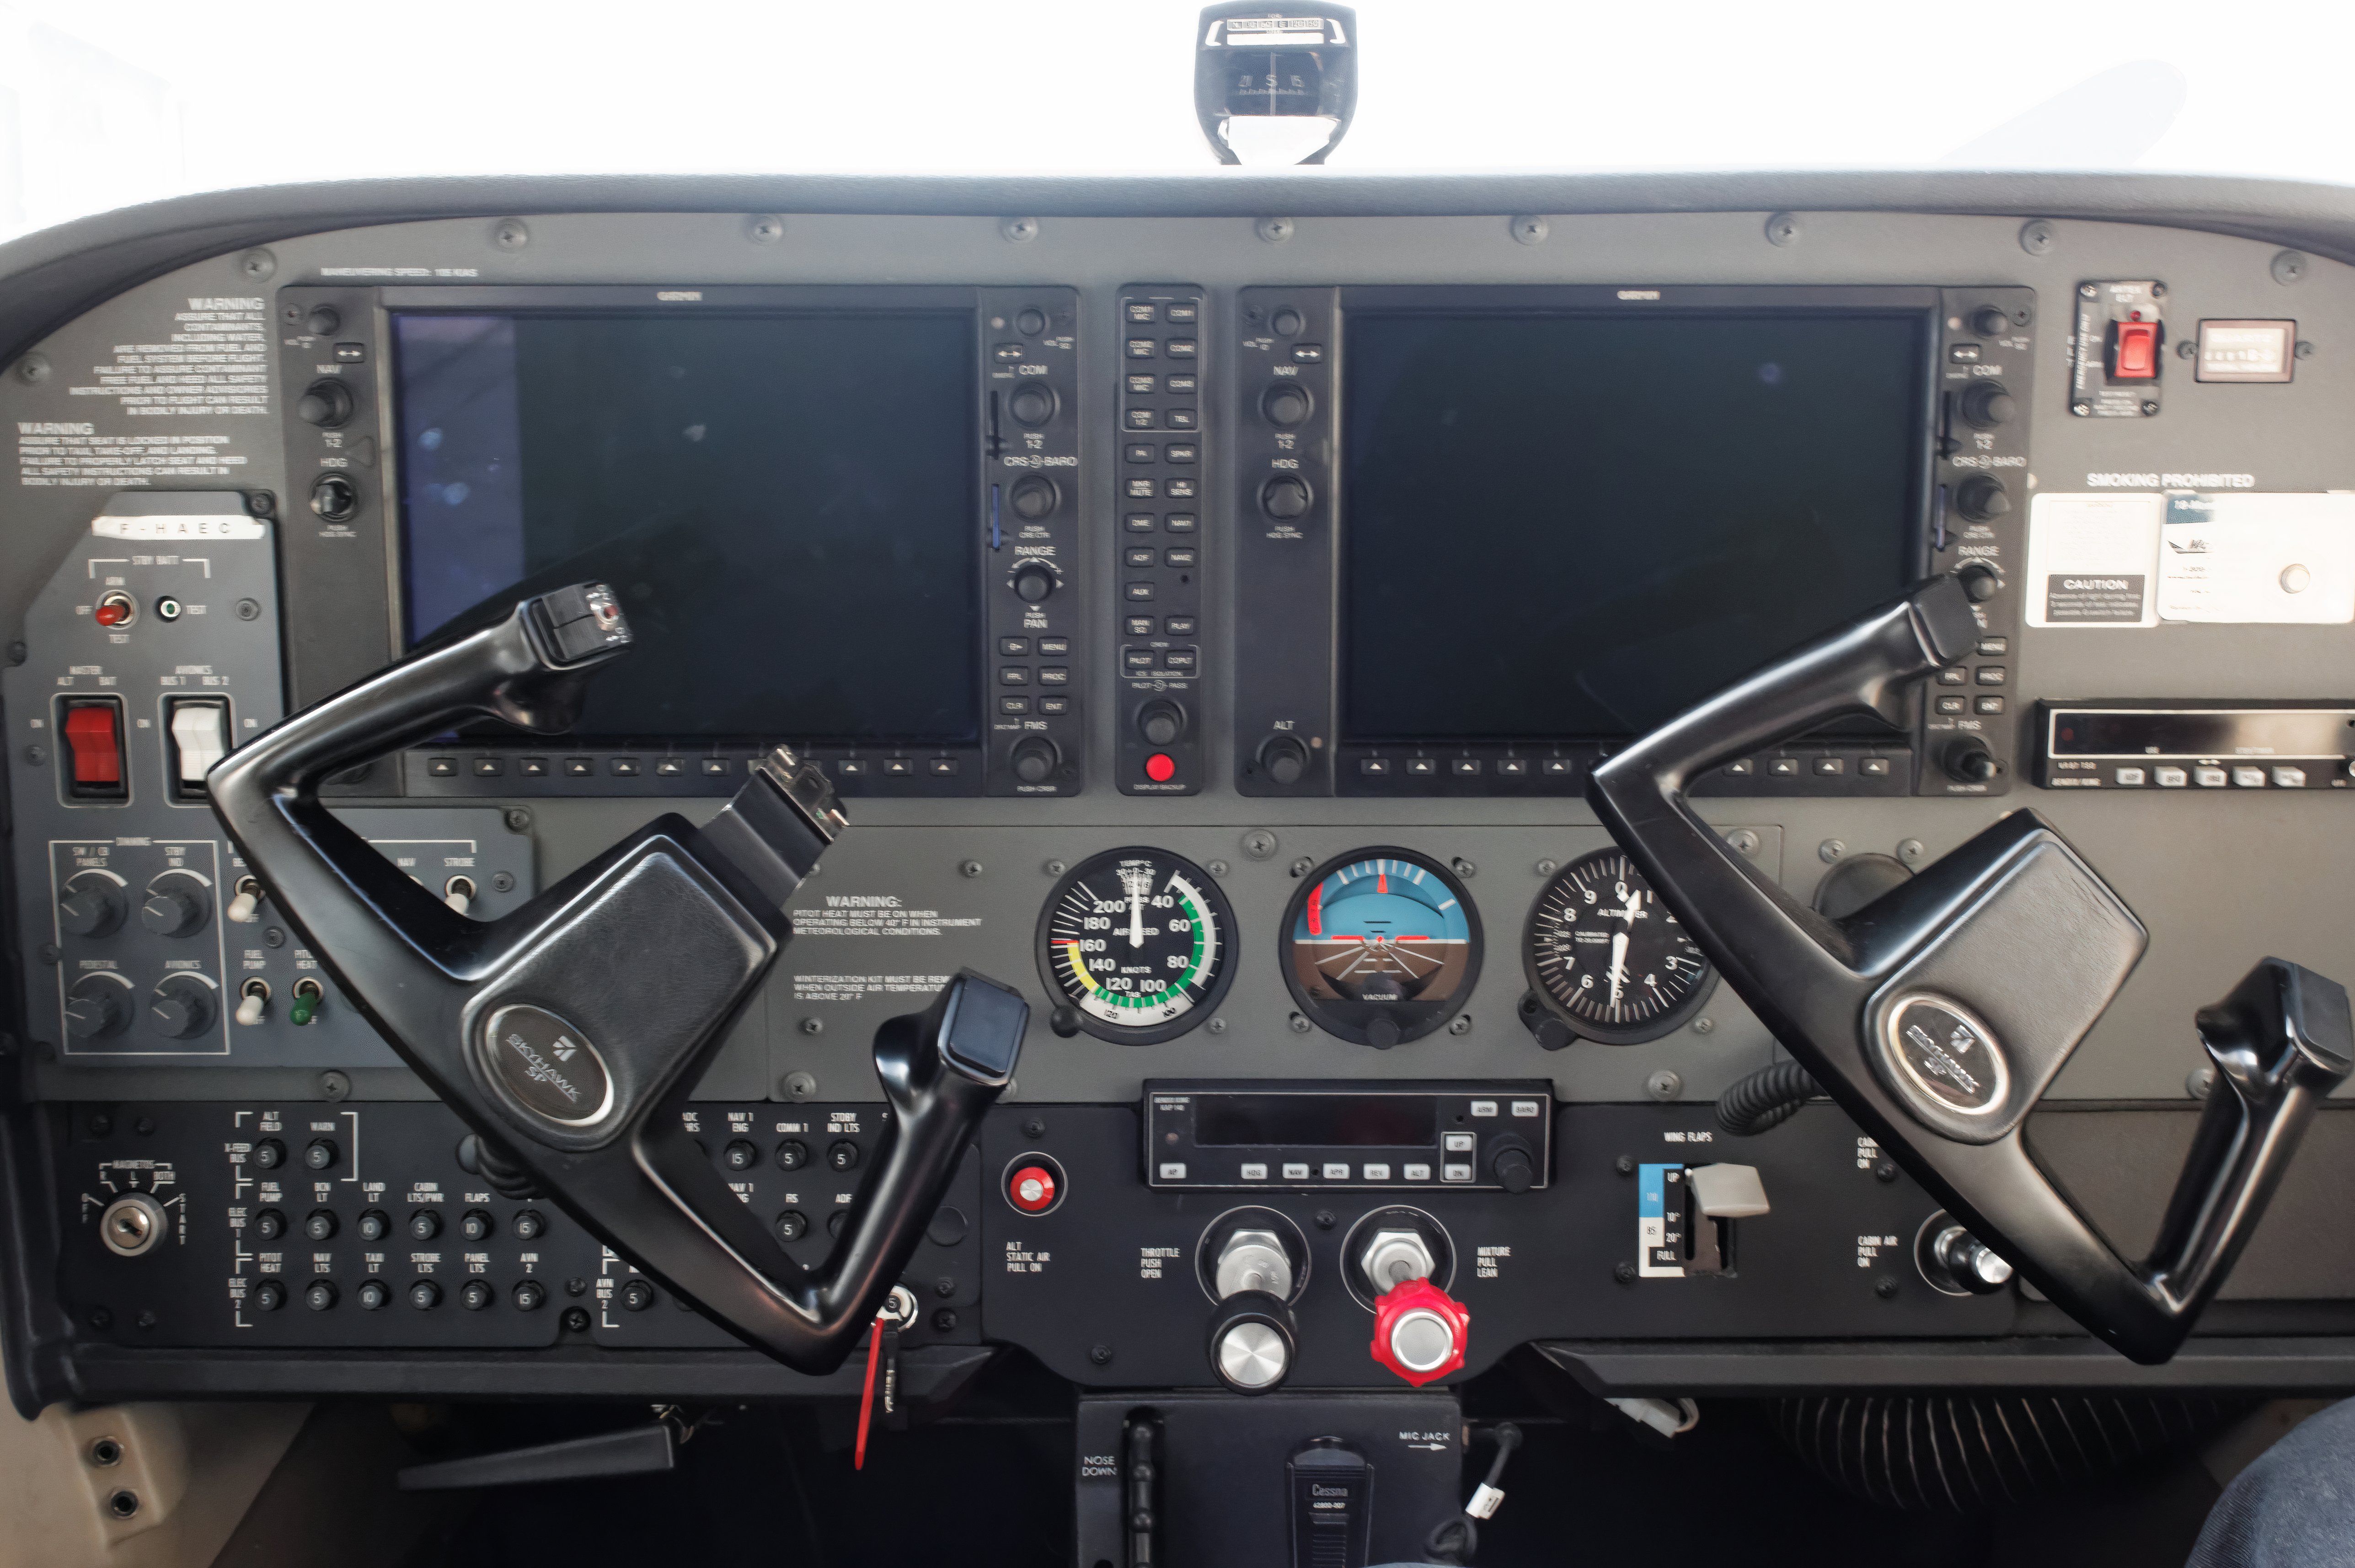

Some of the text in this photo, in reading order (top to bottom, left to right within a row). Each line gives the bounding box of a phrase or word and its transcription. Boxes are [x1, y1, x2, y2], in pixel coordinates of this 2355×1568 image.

[188, 298, 265, 310] WARNING
[18, 423, 94, 435] WARNING
[2087, 473, 2255, 487] SMOKING PROHIBITED
[1015, 546, 1056, 555] RANGE
[2063, 579, 2129, 591] CAUTION
[1024, 619, 1048, 628] PAN
[1273, 720, 1295, 730] ALT
[1151, 896, 1174, 908] 40
[1584, 890, 1597, 904] 9
[1093, 901, 1126, 913] 200
[1563, 907, 1577, 922] 8
[1084, 917, 1111, 930] 180
[1169, 919, 1191, 932] 60
[1080, 939, 1107, 952] 160
[1089, 959, 1116, 971] 140
[1167, 955, 1189, 968] 80
[1563, 956, 1575, 970] 7
[1665, 956, 1678, 970] 3
[1106, 978, 1133, 990] 120
[1581, 975, 1594, 988] 6
[1644, 974, 1657, 987] 4
[1140, 980, 1167, 992] 100
[728, 1113, 754, 1122] NAV 1
[776, 1123, 808, 1132] COMM 1
[827, 1123, 860, 1132] IND LTS
[1664, 1131, 1713, 1142] WING FLAPS
[261, 1151, 269, 1162] 5
[313, 1152, 321, 1162] 5
[732, 1153, 744, 1163] 15
[785, 1153, 793, 1163] 5
[1857, 1148, 1878, 1158] PULL
[837, 1154, 846, 1164] 5
[1857, 1158, 1870, 1168] ON
[1667, 1172, 1680, 1182] UP
[748, 1183, 754, 1192] 1
[369, 1193, 380, 1202] LT
[465, 1193, 490, 1202] FLAPS
[262, 1222, 271, 1232] 5
[313, 1223, 321, 1232] 5
[363, 1223, 374, 1233] 10
[417, 1223, 426, 1232] 5
[466, 1223, 477, 1232] 10
[519, 1223, 530, 1232] 15
[784, 1225, 792, 1235] 5
[1884, 1236, 1898, 1246] AIR
[1006, 1242, 1022, 1251] ALT
[1006, 1252, 1050, 1261] STATIC AIR
[1140, 1248, 1180, 1257] THROTTLE
[1657, 1250, 1677, 1260] FULL
[1858, 1247, 1878, 1257] PULL
[1141, 1259, 1161, 1268] PUSH
[1477, 1257, 1498, 1267] PULL
[1857, 1257, 1870, 1267] ON
[525, 1264, 533, 1273] 2
[1007, 1263, 1042, 1272] PULL ON
[1477, 1268, 1498, 1277] LEAN
[1141, 1269, 1162, 1278] OPEN
[261, 1294, 270, 1304] 5
[313, 1293, 321, 1303] 5
[363, 1292, 374, 1302] 10
[417, 1292, 425, 1302] 5
[469, 1293, 477, 1302] 5
[519, 1294, 530, 1303] 15
[629, 1294, 637, 1304] 5
[601, 1300, 608, 1309] 2
[888, 1298, 897, 1309] 5
[1399, 1431, 1451, 1441] MIC JACK
[1084, 1456, 1115, 1466] NOSE
[1082, 1467, 1117, 1476] DOWN
